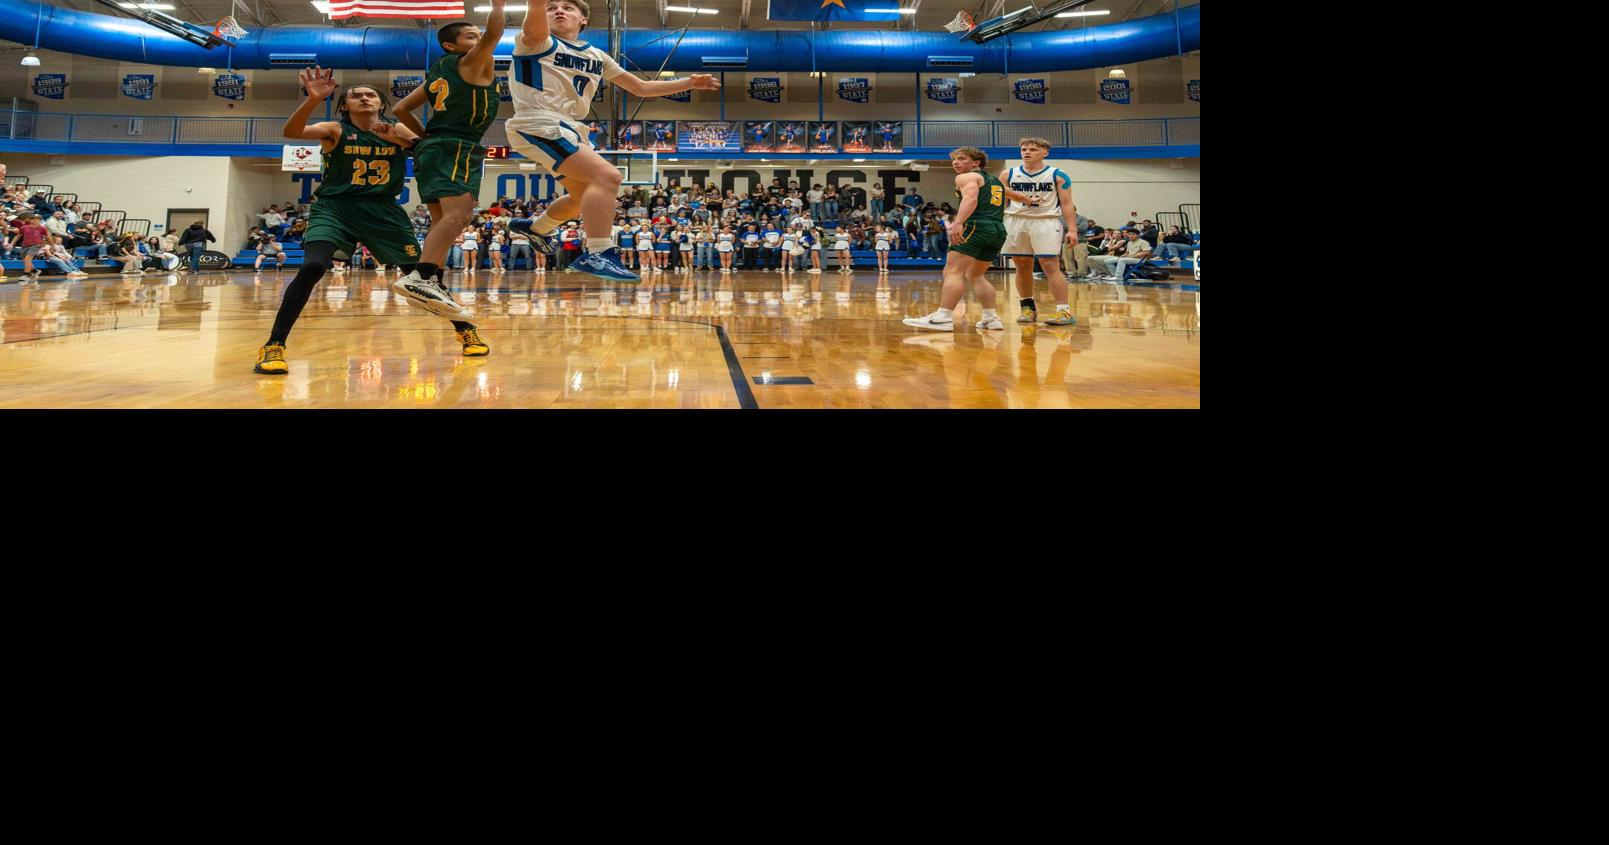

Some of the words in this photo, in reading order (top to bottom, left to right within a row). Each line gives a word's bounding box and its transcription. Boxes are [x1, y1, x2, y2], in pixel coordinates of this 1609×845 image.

[554, 52, 603, 75] SNOWFLAK
[351, 159, 390, 185] 23
[1011, 182, 1053, 192] SNOWFLAKE
